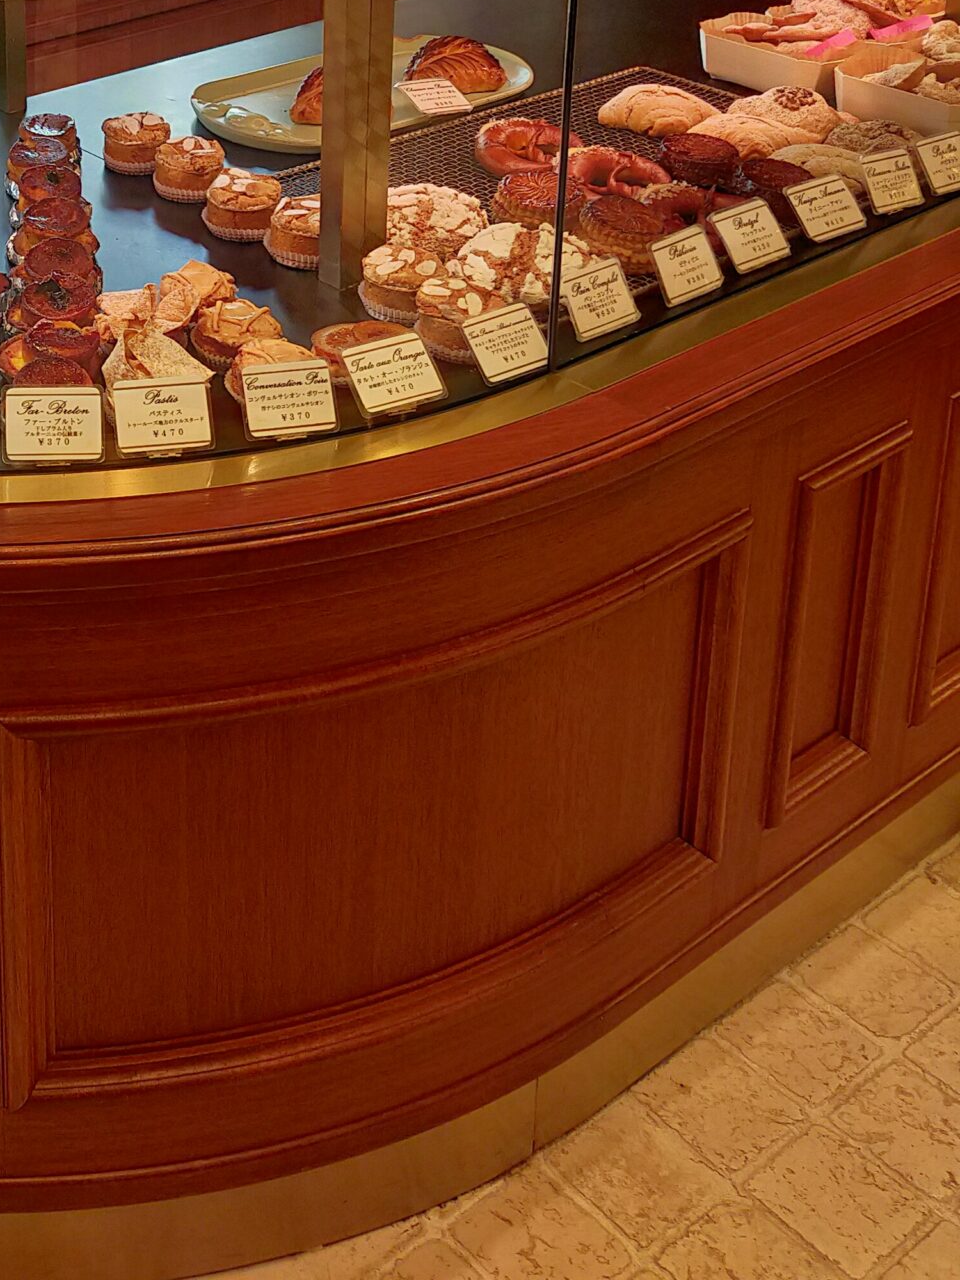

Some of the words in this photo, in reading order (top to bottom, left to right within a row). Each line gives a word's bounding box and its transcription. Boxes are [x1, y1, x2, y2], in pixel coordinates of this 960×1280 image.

[350, 357, 374, 374] Tarte
[376, 359, 391, 369] aux
[392, 347, 426, 363] Oranges
[245, 376, 303, 391] Conversation
[305, 371, 329, 386] Poire
[387, 384, 415, 396] ¥470
[143, 389, 178, 406] Pastis
[149, 408, 183, 418] パスティス
[281, 411, 311, 422] ¥370
[23, 418, 84, 426] ファー・ブルトン
[153, 428, 184, 438] ¥470
[38, 438, 70, 447] ¥370
